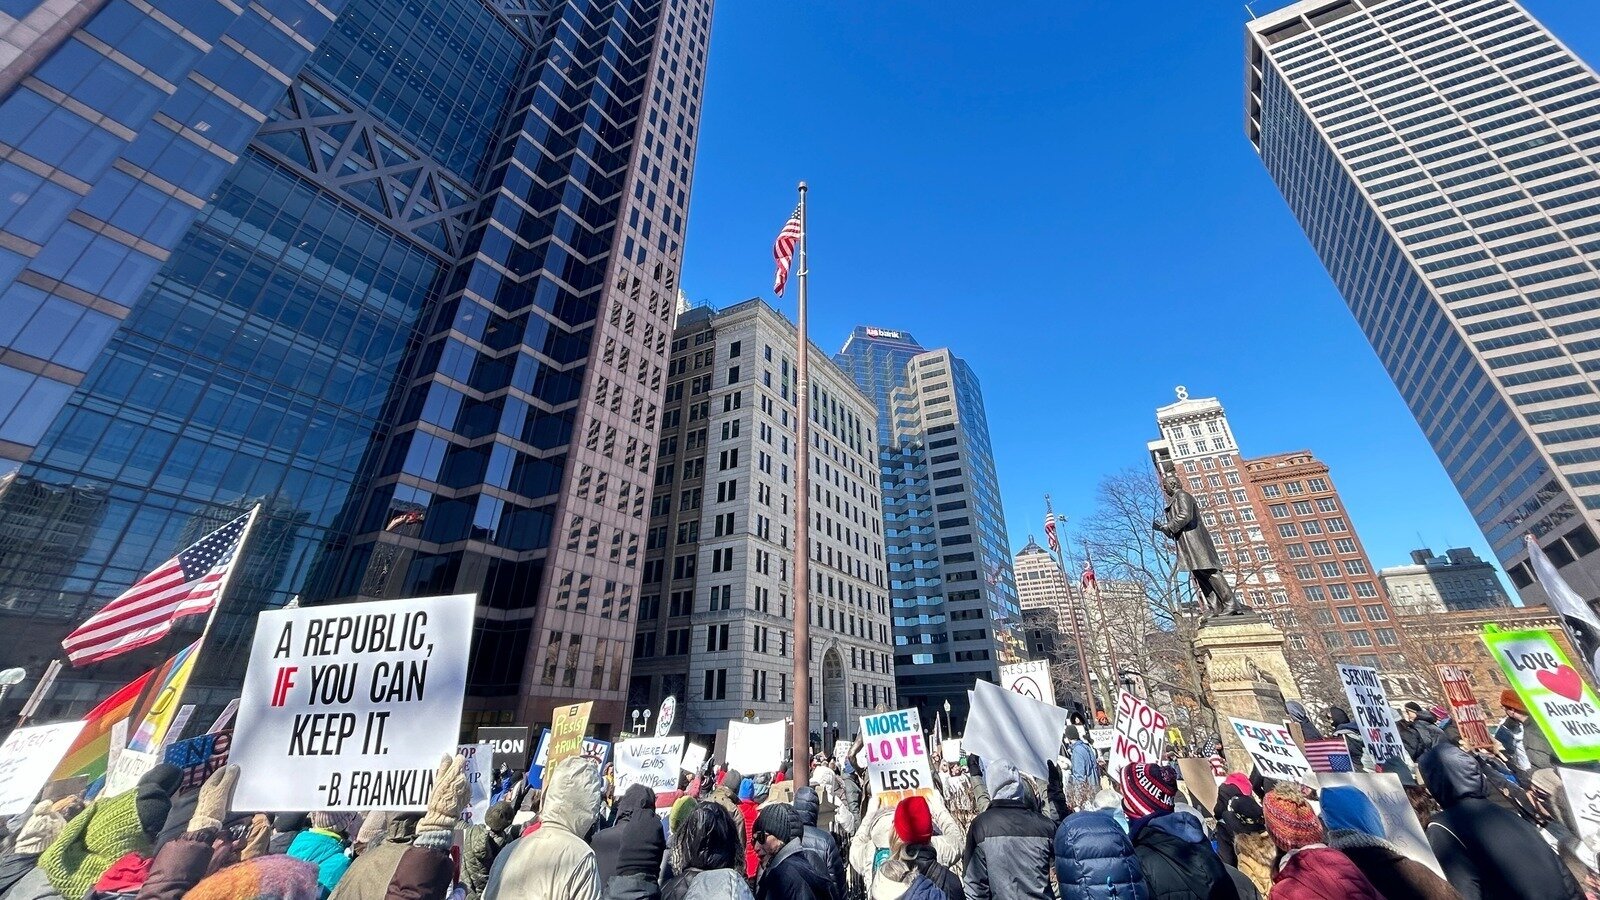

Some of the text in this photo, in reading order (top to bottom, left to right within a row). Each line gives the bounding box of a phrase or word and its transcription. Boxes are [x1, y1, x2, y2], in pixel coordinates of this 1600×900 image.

[879, 328, 899, 339] bank
[1174, 385, 1189, 401] 8
[274, 611, 434, 659] A REPUBLIC,
[1002, 661, 1044, 676] RESIST
[1503, 649, 1558, 671] Love
[271, 660, 428, 707] IF YOU CAN
[1342, 668, 1380, 688] SERVANT
[1354, 687, 1385, 706] to the
[1120, 693, 1168, 733] STOP
[1356, 706, 1389, 727] PUBLIC
[1544, 701, 1596, 717] Always
[288, 711, 390, 756] KEEP IT.
[865, 712, 911, 737] MORE
[1234, 722, 1296, 746] PEOPLE
[1561, 720, 1600, 736] Wins
[1116, 710, 1162, 760] ELON
[1367, 728, 1384, 743] NOT
[630, 744, 681, 757] WHERE LAW
[867, 735, 924, 762] LOVE
[1259, 742, 1293, 757] OVER
[641, 759, 665, 769] ENDS
[1251, 751, 1308, 778] PROFIT
[652, 775, 678, 787] BEGINS
[880, 768, 921, 791] LESS
